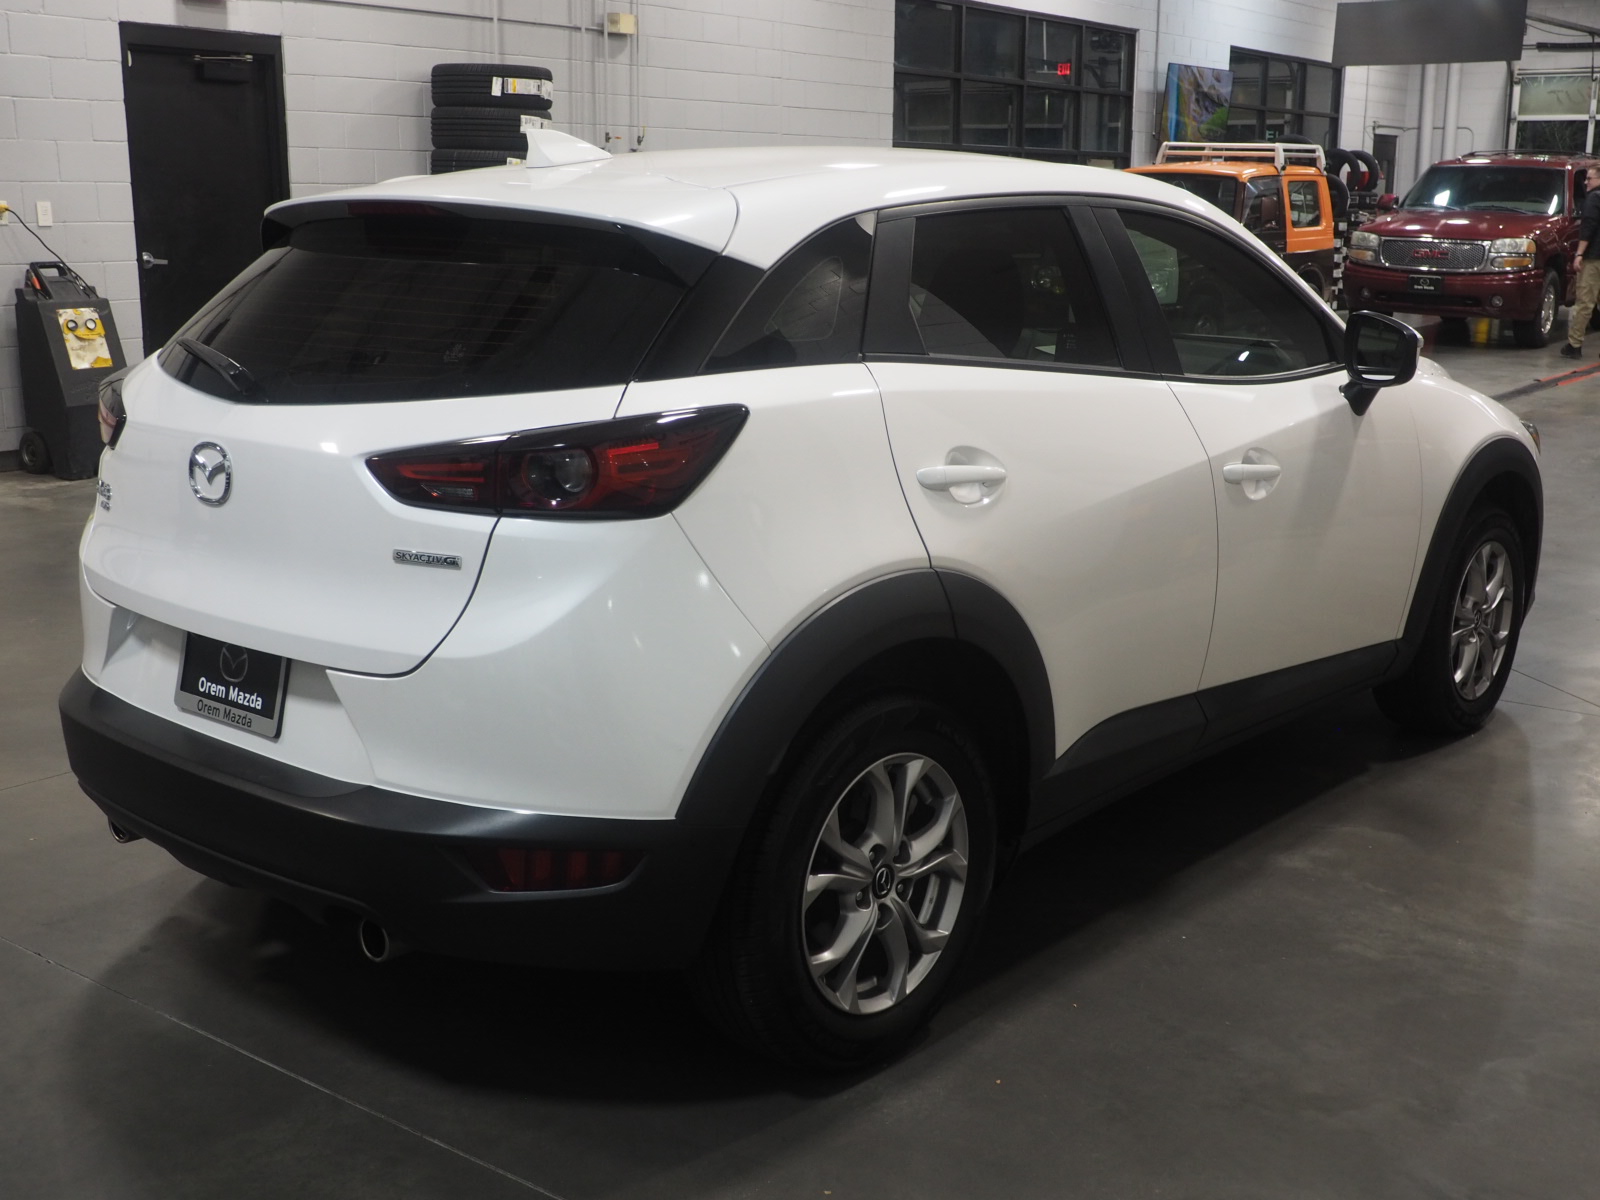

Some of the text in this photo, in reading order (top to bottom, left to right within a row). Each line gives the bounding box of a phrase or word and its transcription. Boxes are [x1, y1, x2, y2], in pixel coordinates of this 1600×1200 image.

[1413, 249, 1450, 259] GMC
[198, 677, 263, 710] Orem Mazda
[196, 699, 252, 728] Orem Mazda
